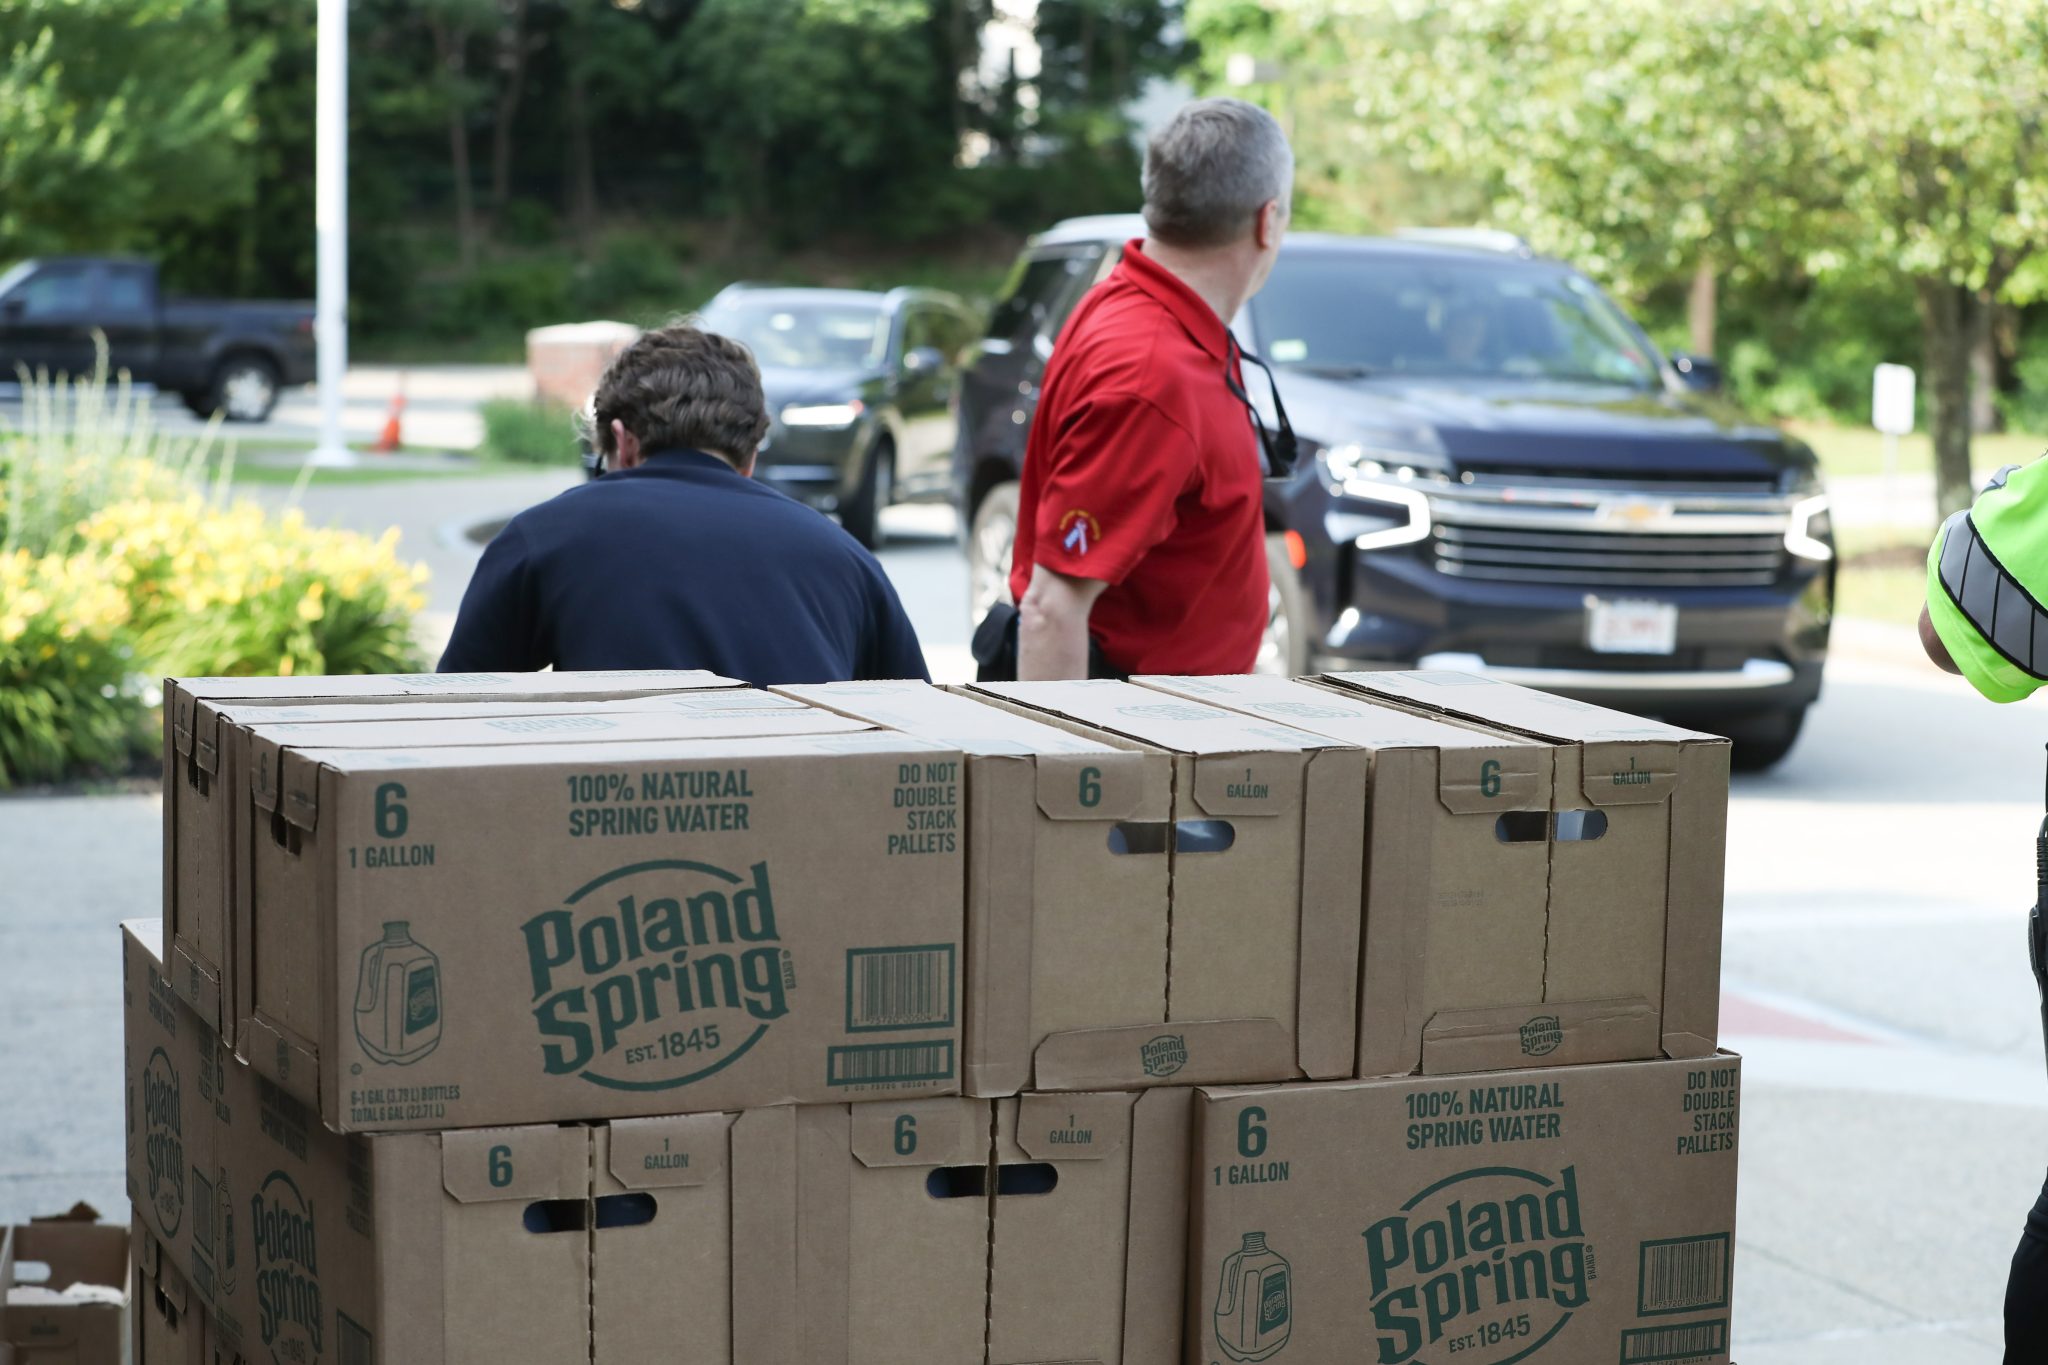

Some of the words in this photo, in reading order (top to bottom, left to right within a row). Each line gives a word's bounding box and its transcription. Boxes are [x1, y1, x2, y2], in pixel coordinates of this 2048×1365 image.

[899, 763, 921, 784] DO
[926, 762, 957, 783] NOT
[1245, 768, 1251, 782] 1
[1629, 756, 1636, 770] 1
[567, 773, 635, 803] 100%
[641, 769, 754, 800] NATURAL
[1078, 767, 1102, 808] 6
[1481, 760, 1501, 798] 6
[1612, 771, 1651, 786] GALLON
[894, 786, 956, 808] DOUBLE
[1226, 784, 1268, 799] GALLON
[375, 782, 408, 838] 6
[568, 806, 658, 837] SPRING
[665, 803, 750, 833] WATER
[907, 809, 956, 831] STACK
[888, 832, 956, 855] PALLETS
[349, 847, 356, 869] 1
[365, 844, 434, 868] GALLON
[520, 861, 781, 1002] Poland
[532, 946, 790, 1075] Spring
[1520, 1016, 1560, 1041] Poland
[625, 1046, 656, 1064] EST.
[657, 1024, 721, 1060] 1845
[1141, 1035, 1185, 1060] Poland
[1521, 1031, 1563, 1054] Spring
[1142, 1050, 1188, 1075] Spring
[1688, 1071, 1706, 1090] DO
[1711, 1069, 1736, 1088] NOT
[144, 1067, 182, 1139] Poland
[367, 1089, 384, 1105] GAL
[421, 1085, 460, 1101] BOTTLES
[1406, 1091, 1463, 1119] 100%
[1469, 1083, 1564, 1115] NATURAL
[1684, 1090, 1735, 1112] DOUBLE
[350, 1106, 378, 1123] TOTAL
[387, 1105, 404, 1121] GAL
[1069, 1114, 1075, 1127] 1
[1694, 1111, 1734, 1132] STACK
[894, 1114, 917, 1156] 6
[1049, 1130, 1092, 1144] GALLON
[1238, 1106, 1267, 1158] 6
[1406, 1119, 1483, 1150] SPRING
[1489, 1113, 1561, 1143] WATER
[1677, 1132, 1733, 1155] PALLETS
[663, 1138, 669, 1151] 1
[147, 1126, 184, 1205] Spring
[488, 1145, 513, 1187] 6
[644, 1154, 689, 1170] GALLON
[1214, 1166, 1221, 1186] 1
[1228, 1161, 1290, 1185] GALLON
[252, 1193, 319, 1280] Poland
[1361, 1165, 1585, 1301] Poland
[1585, 1254, 1597, 1280] BRAND
[256, 1262, 323, 1354] Spring
[1369, 1243, 1590, 1365] Spring
[1449, 1334, 1476, 1352] EST.
[1477, 1314, 1531, 1347] 1845
